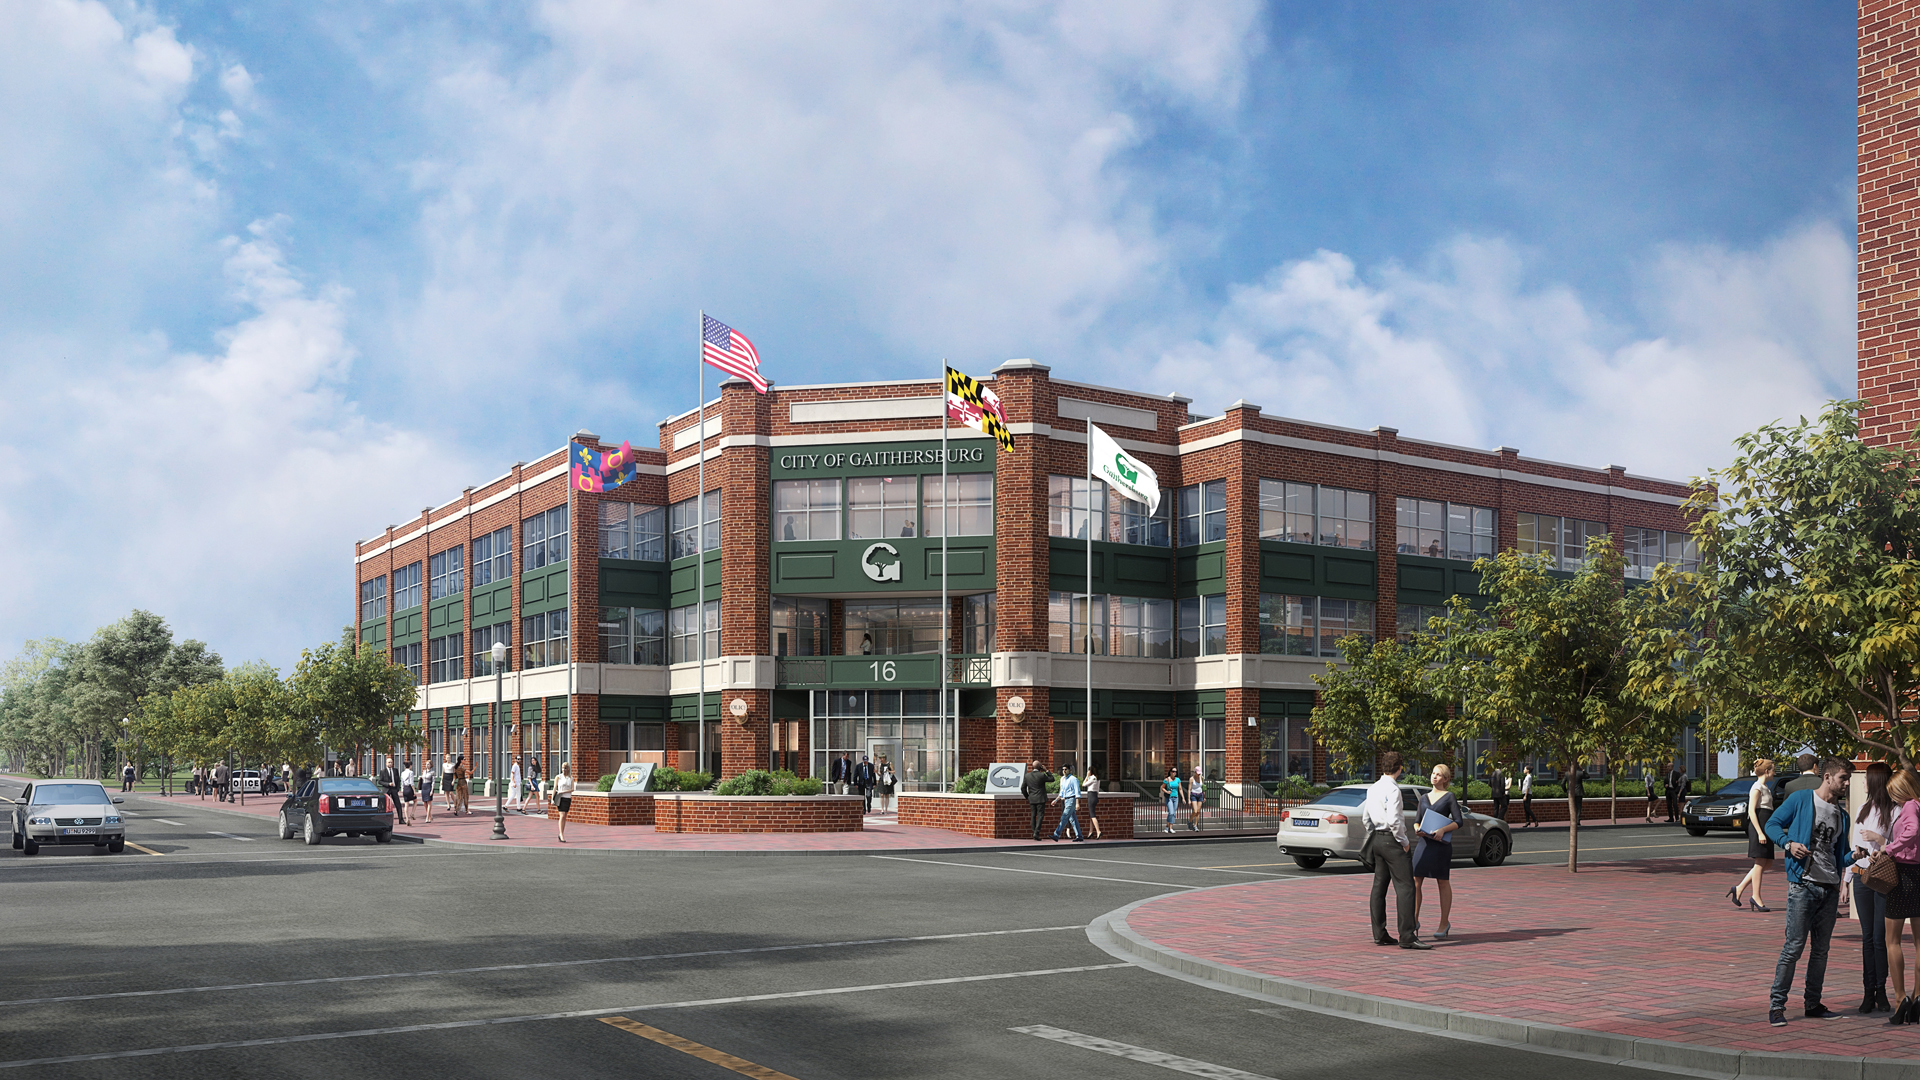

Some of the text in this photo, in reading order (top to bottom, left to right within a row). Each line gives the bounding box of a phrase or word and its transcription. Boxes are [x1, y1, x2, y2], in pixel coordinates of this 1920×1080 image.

[780, 447, 984, 469] CITY OF GAITHERSBURG
[869, 660, 896, 682] 16
